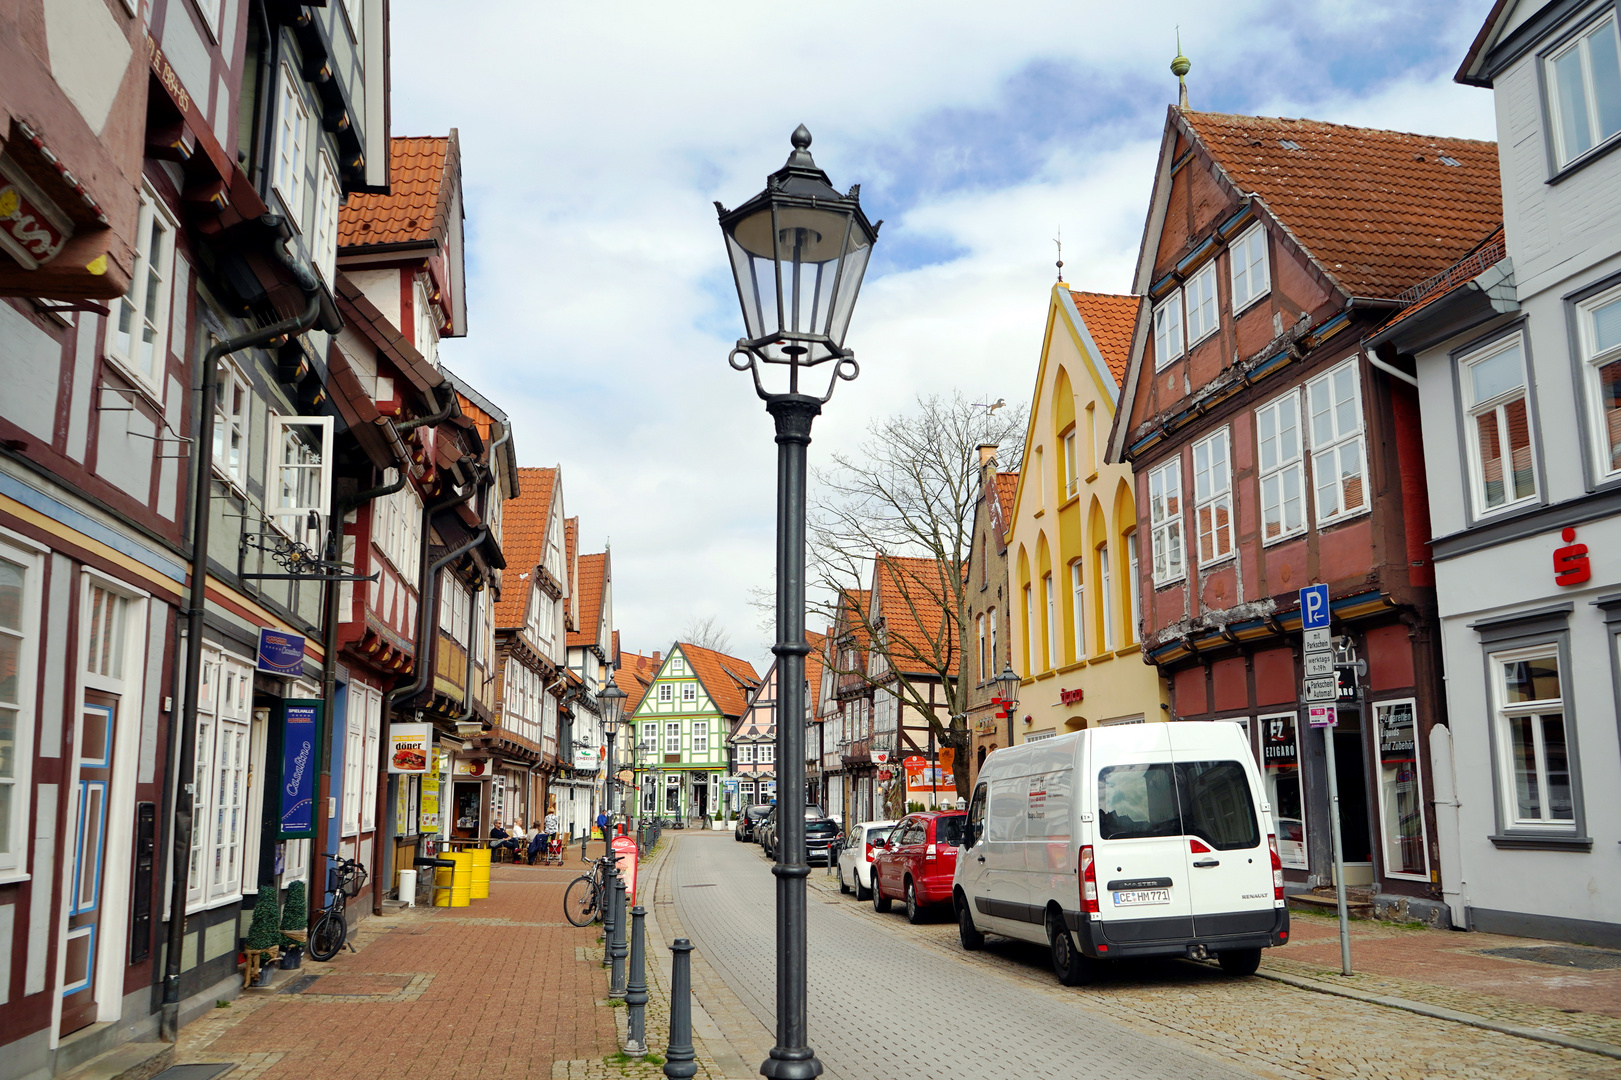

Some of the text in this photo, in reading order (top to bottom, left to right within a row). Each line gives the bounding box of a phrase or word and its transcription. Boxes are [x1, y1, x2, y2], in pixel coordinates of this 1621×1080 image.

[1306, 591, 1322, 623] P
[1306, 640, 1329, 648] Parkschein
[1308, 656, 1331, 664] werktags
[1310, 680, 1333, 689] Parkschein
[1313, 689, 1332, 698] Automat
[1380, 727, 1400, 738] Liquids
[395, 742, 422, 750] döner
[1381, 739, 1414, 751] und Zubehör
[1120, 892, 1132, 902] CE
